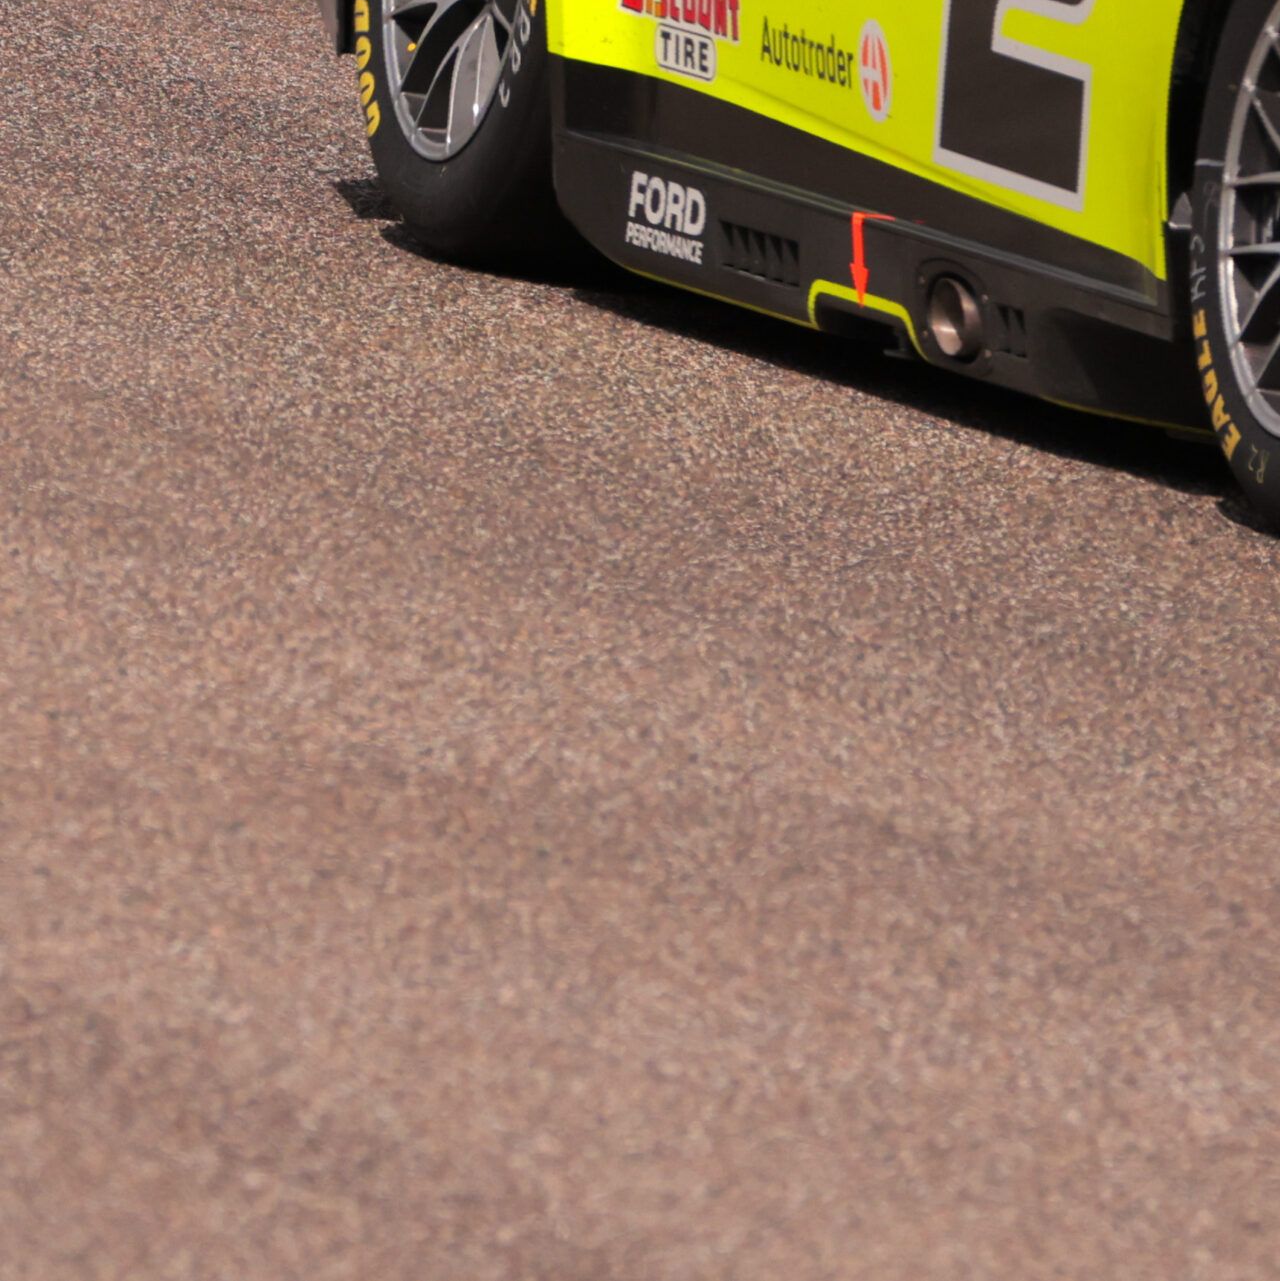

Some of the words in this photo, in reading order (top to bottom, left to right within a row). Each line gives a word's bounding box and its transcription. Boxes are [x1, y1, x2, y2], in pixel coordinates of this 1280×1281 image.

[660, 31, 710, 73] TIRE
[760, 15, 854, 90] Autotrader
[627, 170, 707, 237] FORD
[625, 220, 705, 266] PERFORMANCE
